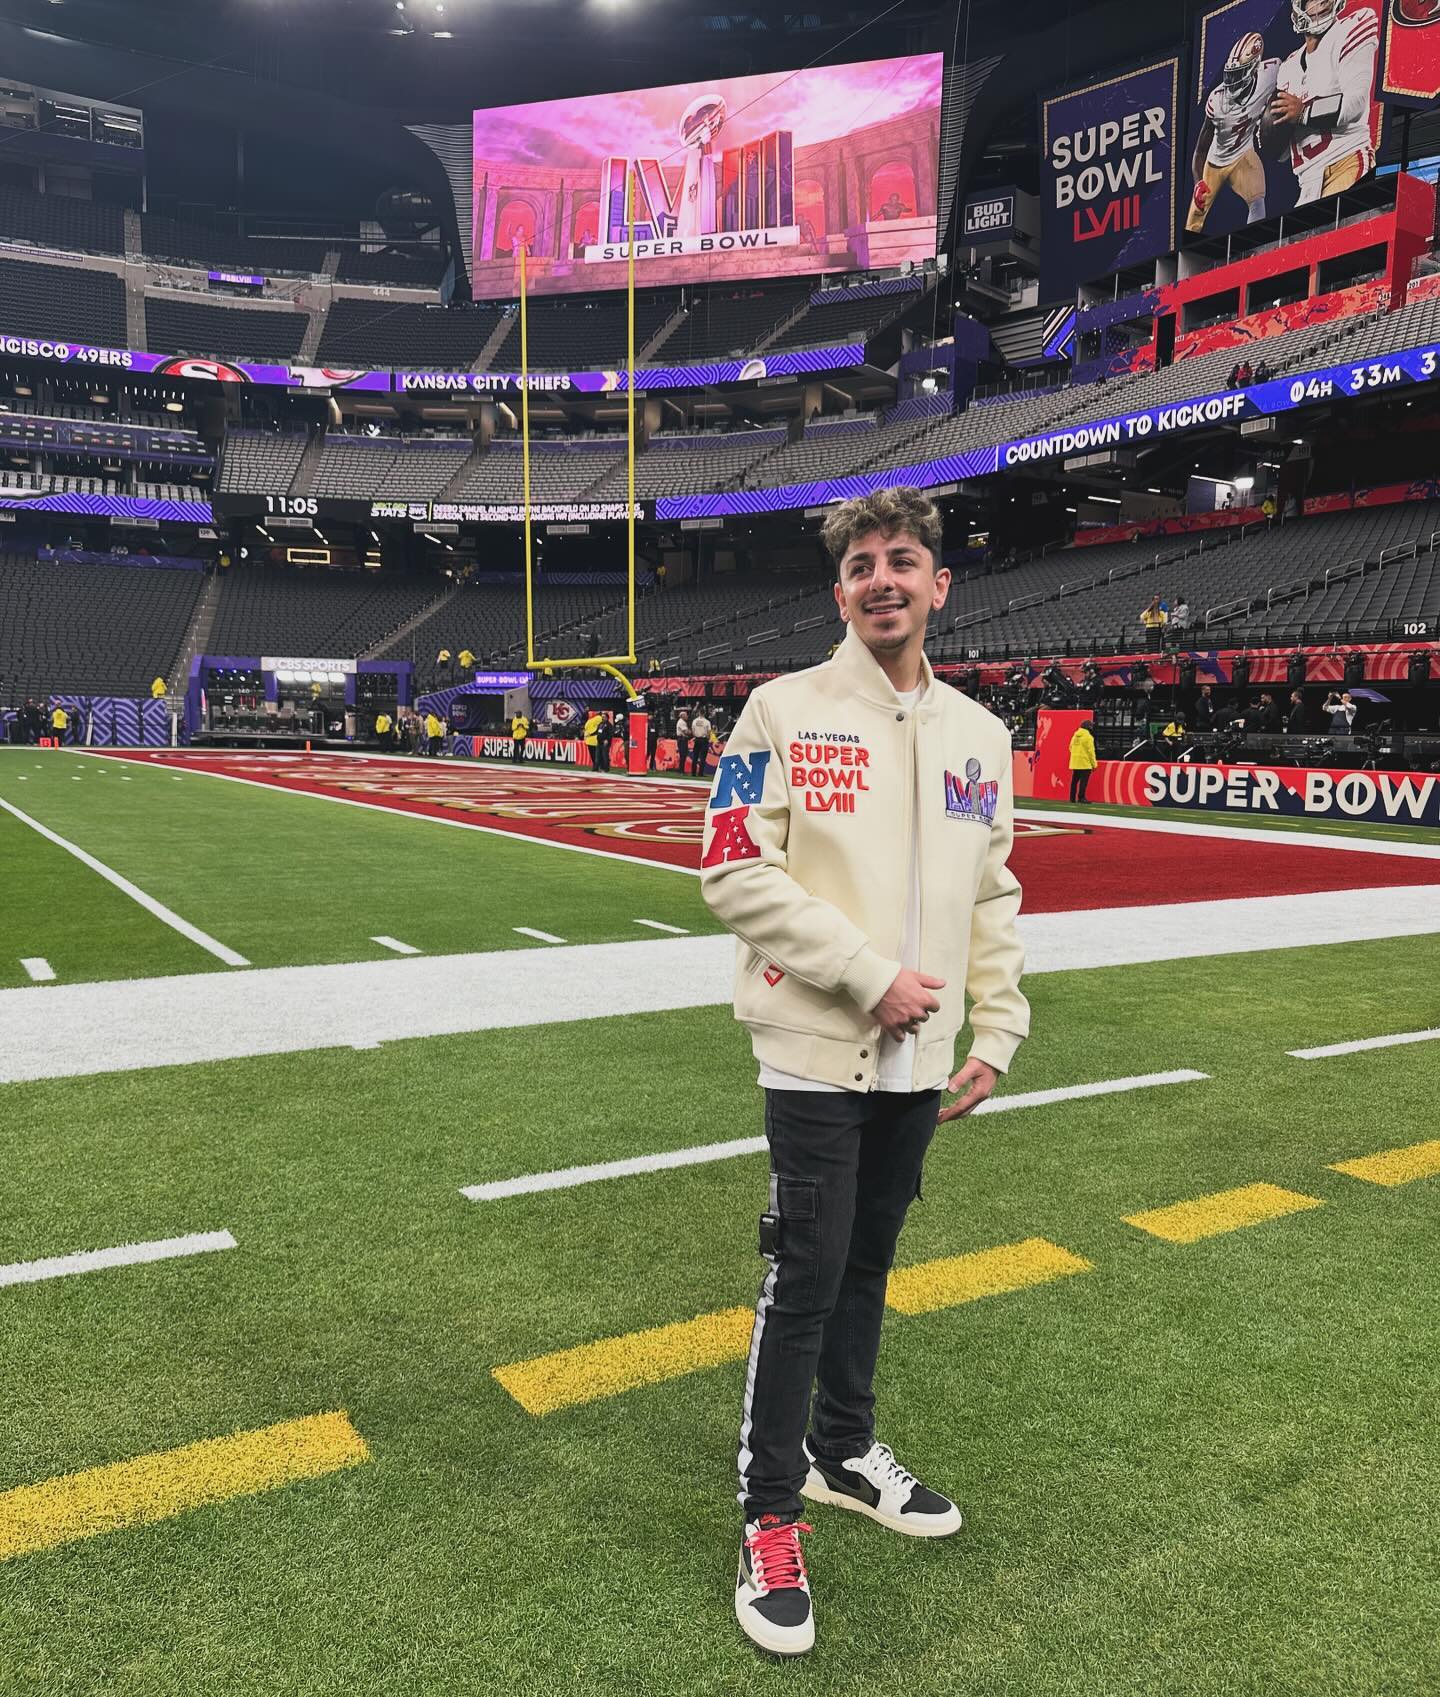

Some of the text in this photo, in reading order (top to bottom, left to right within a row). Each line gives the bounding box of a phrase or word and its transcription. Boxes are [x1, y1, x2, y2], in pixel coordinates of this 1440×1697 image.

[1052, 106, 1166, 170] SUPER
[1056, 150, 1163, 209] BOWL
[973, 201, 1004, 217] BUD
[1073, 194, 1141, 243] LVIII
[967, 212, 1010, 231] LIGHT
[603, 232, 778, 260] SUPER BOWL
[373, 288, 390, 297] 444
[77, 347, 133, 367] 49ERS
[402, 375, 571, 390] KANSAS CITY CHIEFS
[1005, 421, 1120, 465] COUNTDOWN
[1126, 414, 1152, 439] TO
[1158, 393, 1246, 431] KICKOFF
[266, 495, 319, 515] 11:05
[370, 508, 407, 518] STATS
[459, 504, 487, 513] SAMUEL
[1404, 622, 1427, 635] 102
[968, 649, 979, 659] 101
[278, 660, 350, 672] CBS SPORTS
[478, 675, 497, 684] SUPER
[552, 703, 570, 721] KC
[798, 731, 860, 744] LAS VEGAS
[483, 738, 577, 762] SUPER OWL LVIII
[789, 741, 870, 768] SUPER
[709, 750, 771, 809] N
[791, 766, 870, 791] BOWL
[805, 791, 855, 813] LVIII
[1143, 765, 1440, 820] SUPER BOW
[702, 805, 761, 868] A
